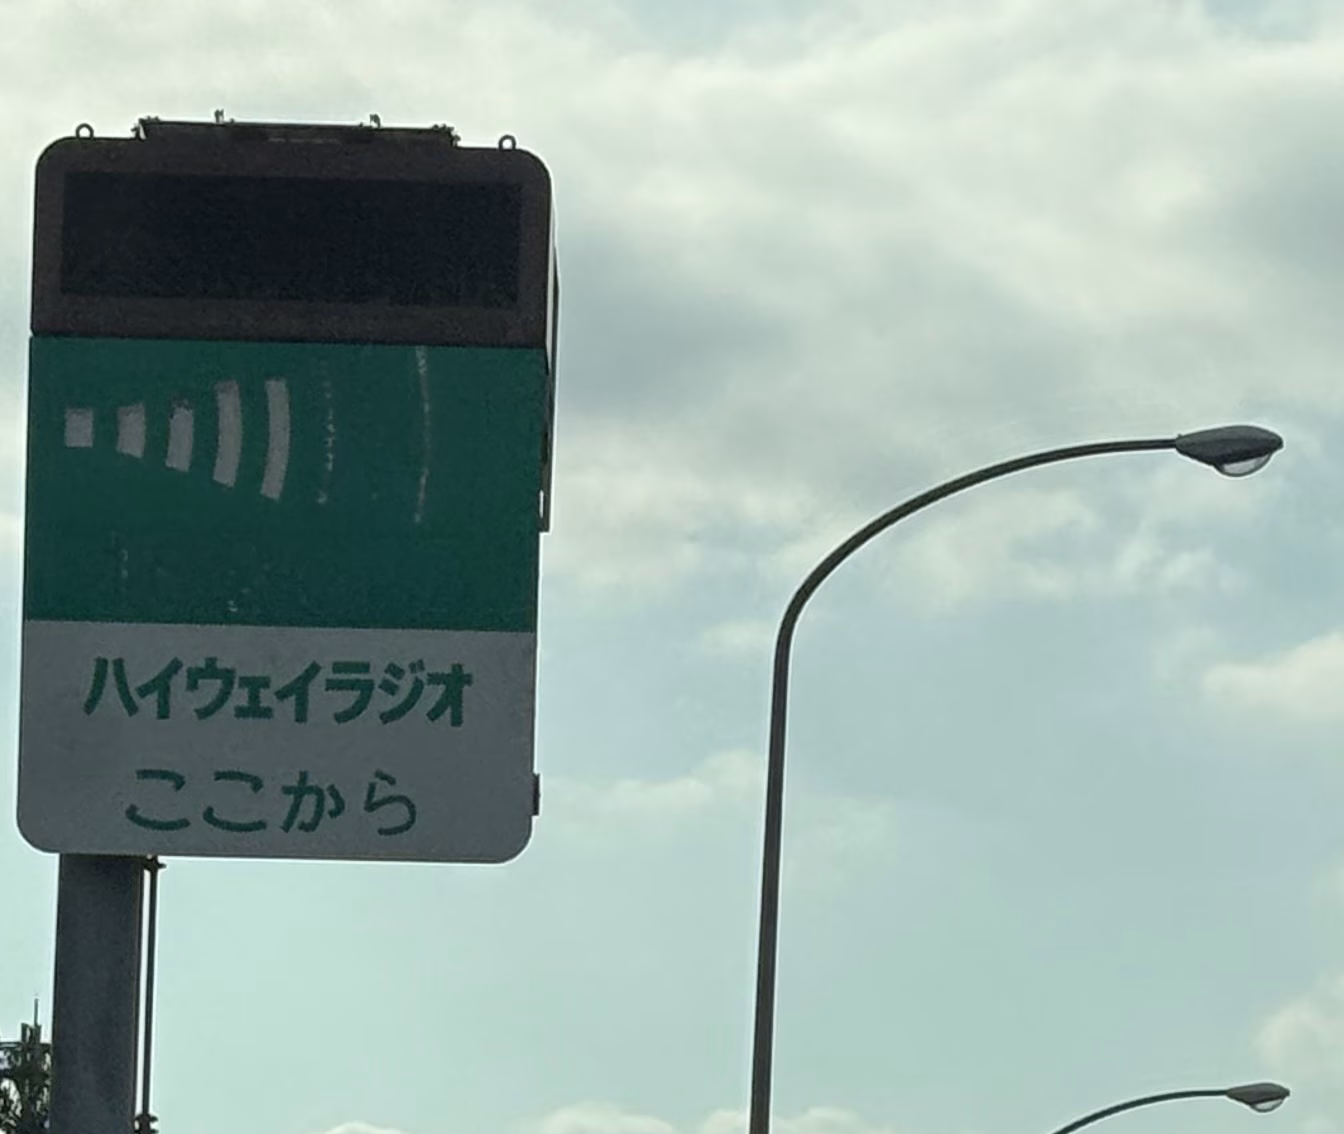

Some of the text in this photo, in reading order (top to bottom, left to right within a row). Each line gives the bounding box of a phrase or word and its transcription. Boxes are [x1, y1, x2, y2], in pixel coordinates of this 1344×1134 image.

[83, 657, 473, 727] ハイウェイラジオ
[125, 769, 417, 836] ここから
